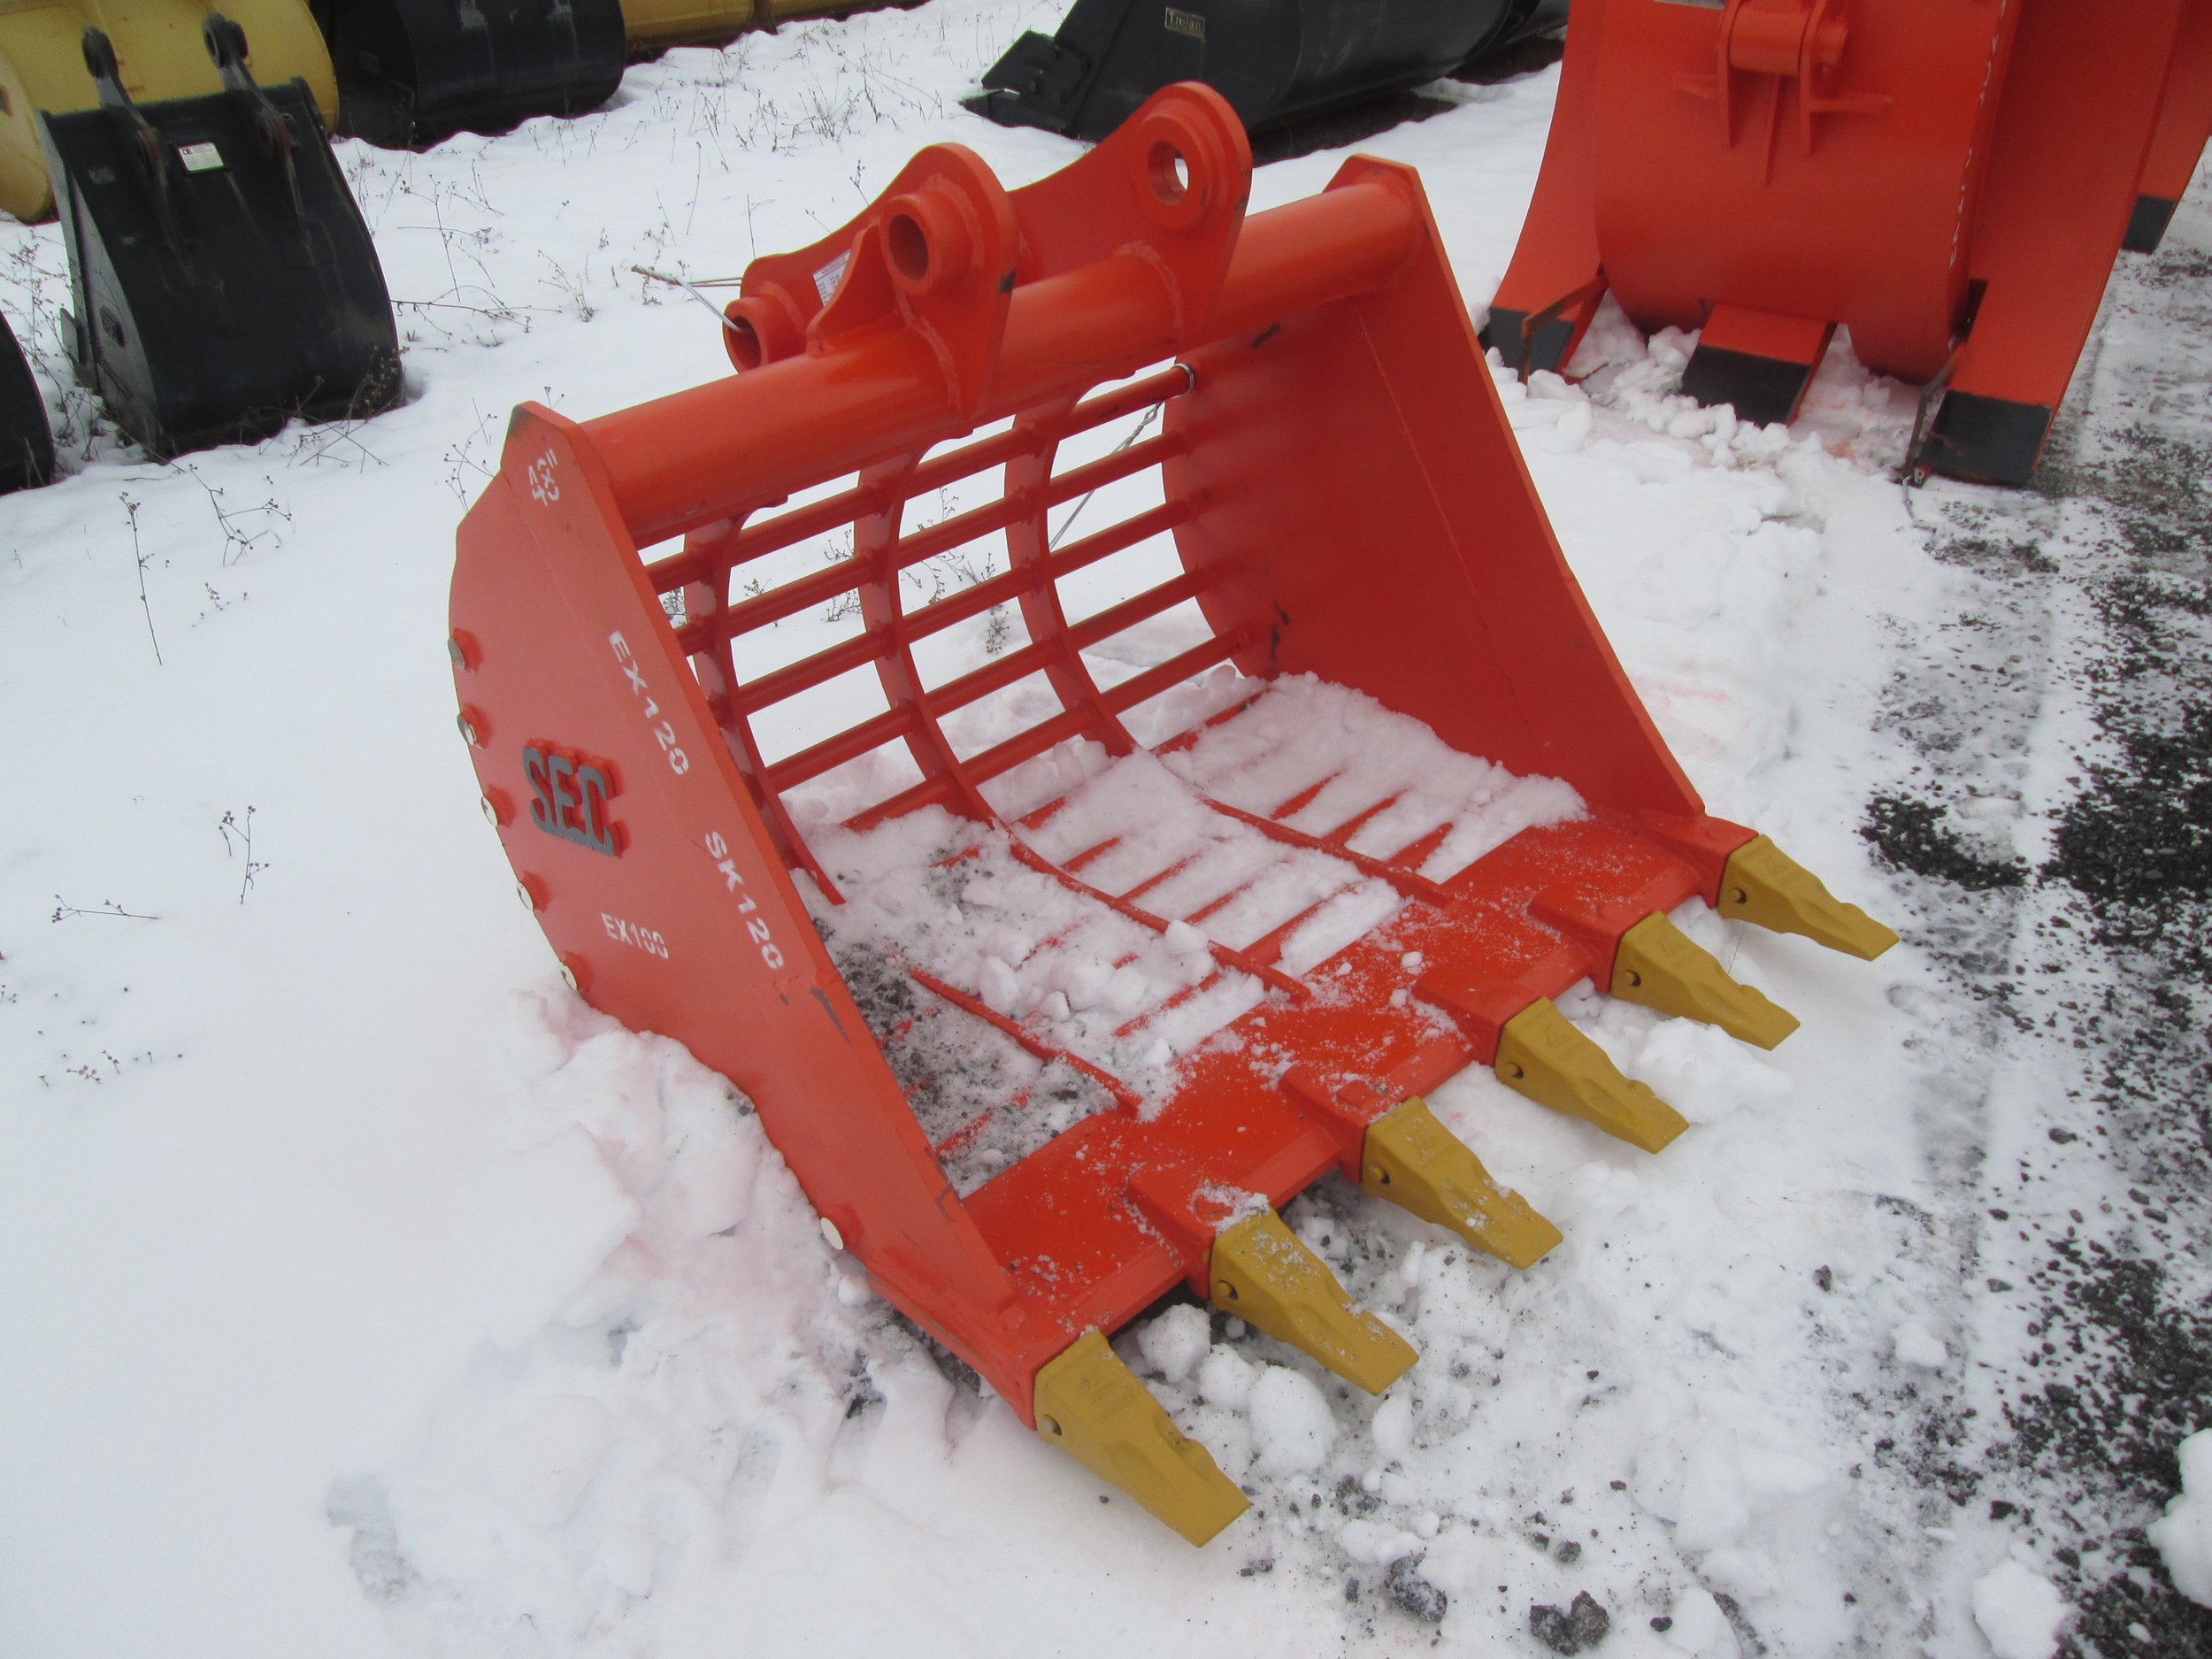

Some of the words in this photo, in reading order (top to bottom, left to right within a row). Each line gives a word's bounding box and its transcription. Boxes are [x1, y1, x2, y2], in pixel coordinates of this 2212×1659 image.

[608, 629, 690, 776] EX120
[522, 747, 615, 857] SEC
[704, 830, 785, 970] SK120
